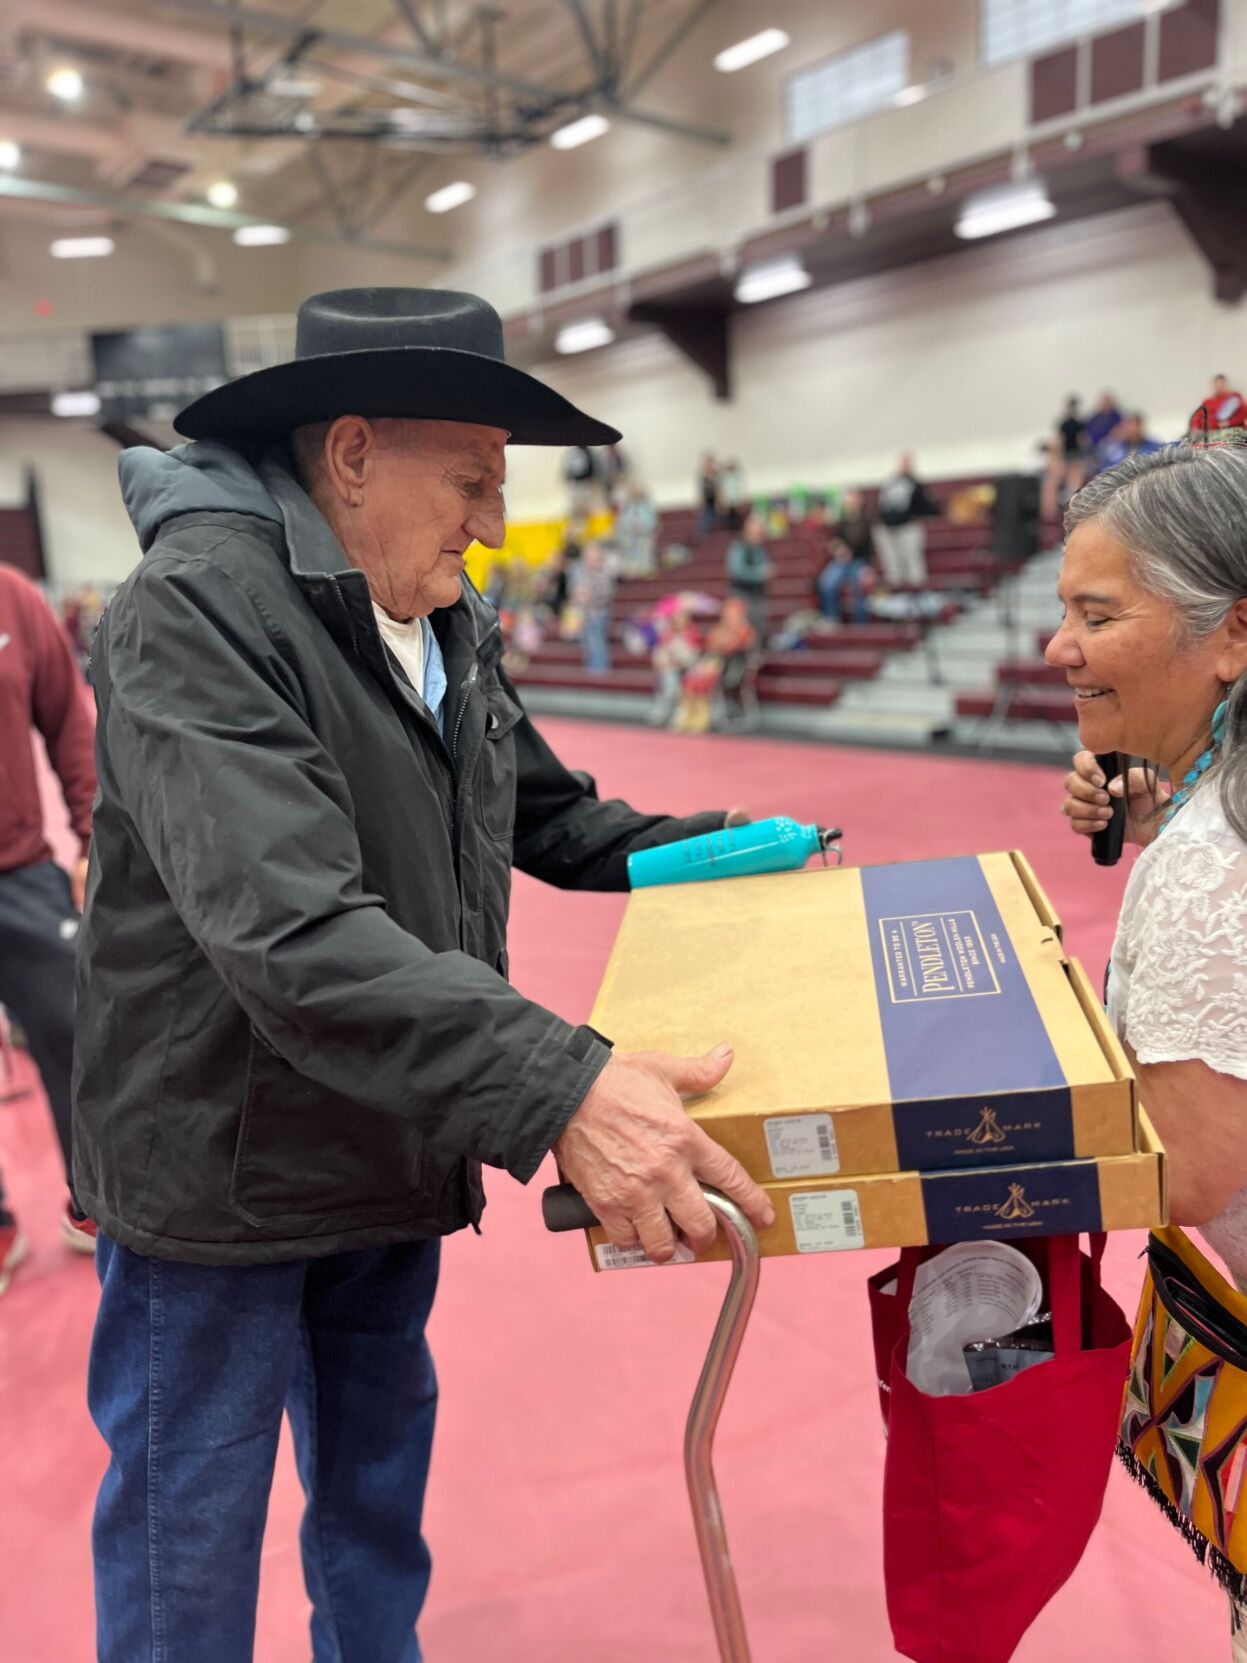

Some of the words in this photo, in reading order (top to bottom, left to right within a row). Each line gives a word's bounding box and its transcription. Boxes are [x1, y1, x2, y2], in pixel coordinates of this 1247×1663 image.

[891, 934, 900, 942] BE
[894, 951, 908, 987] WARRANTED
[911, 922, 956, 992] PENDLETON
[959, 955, 975, 989] PENDLETON
[926, 1127, 972, 1138] TRADE
[1003, 1121, 1041, 1131] MARK
[954, 1203, 1001, 1213] TRADE
[1031, 1198, 1070, 1206] MARK
